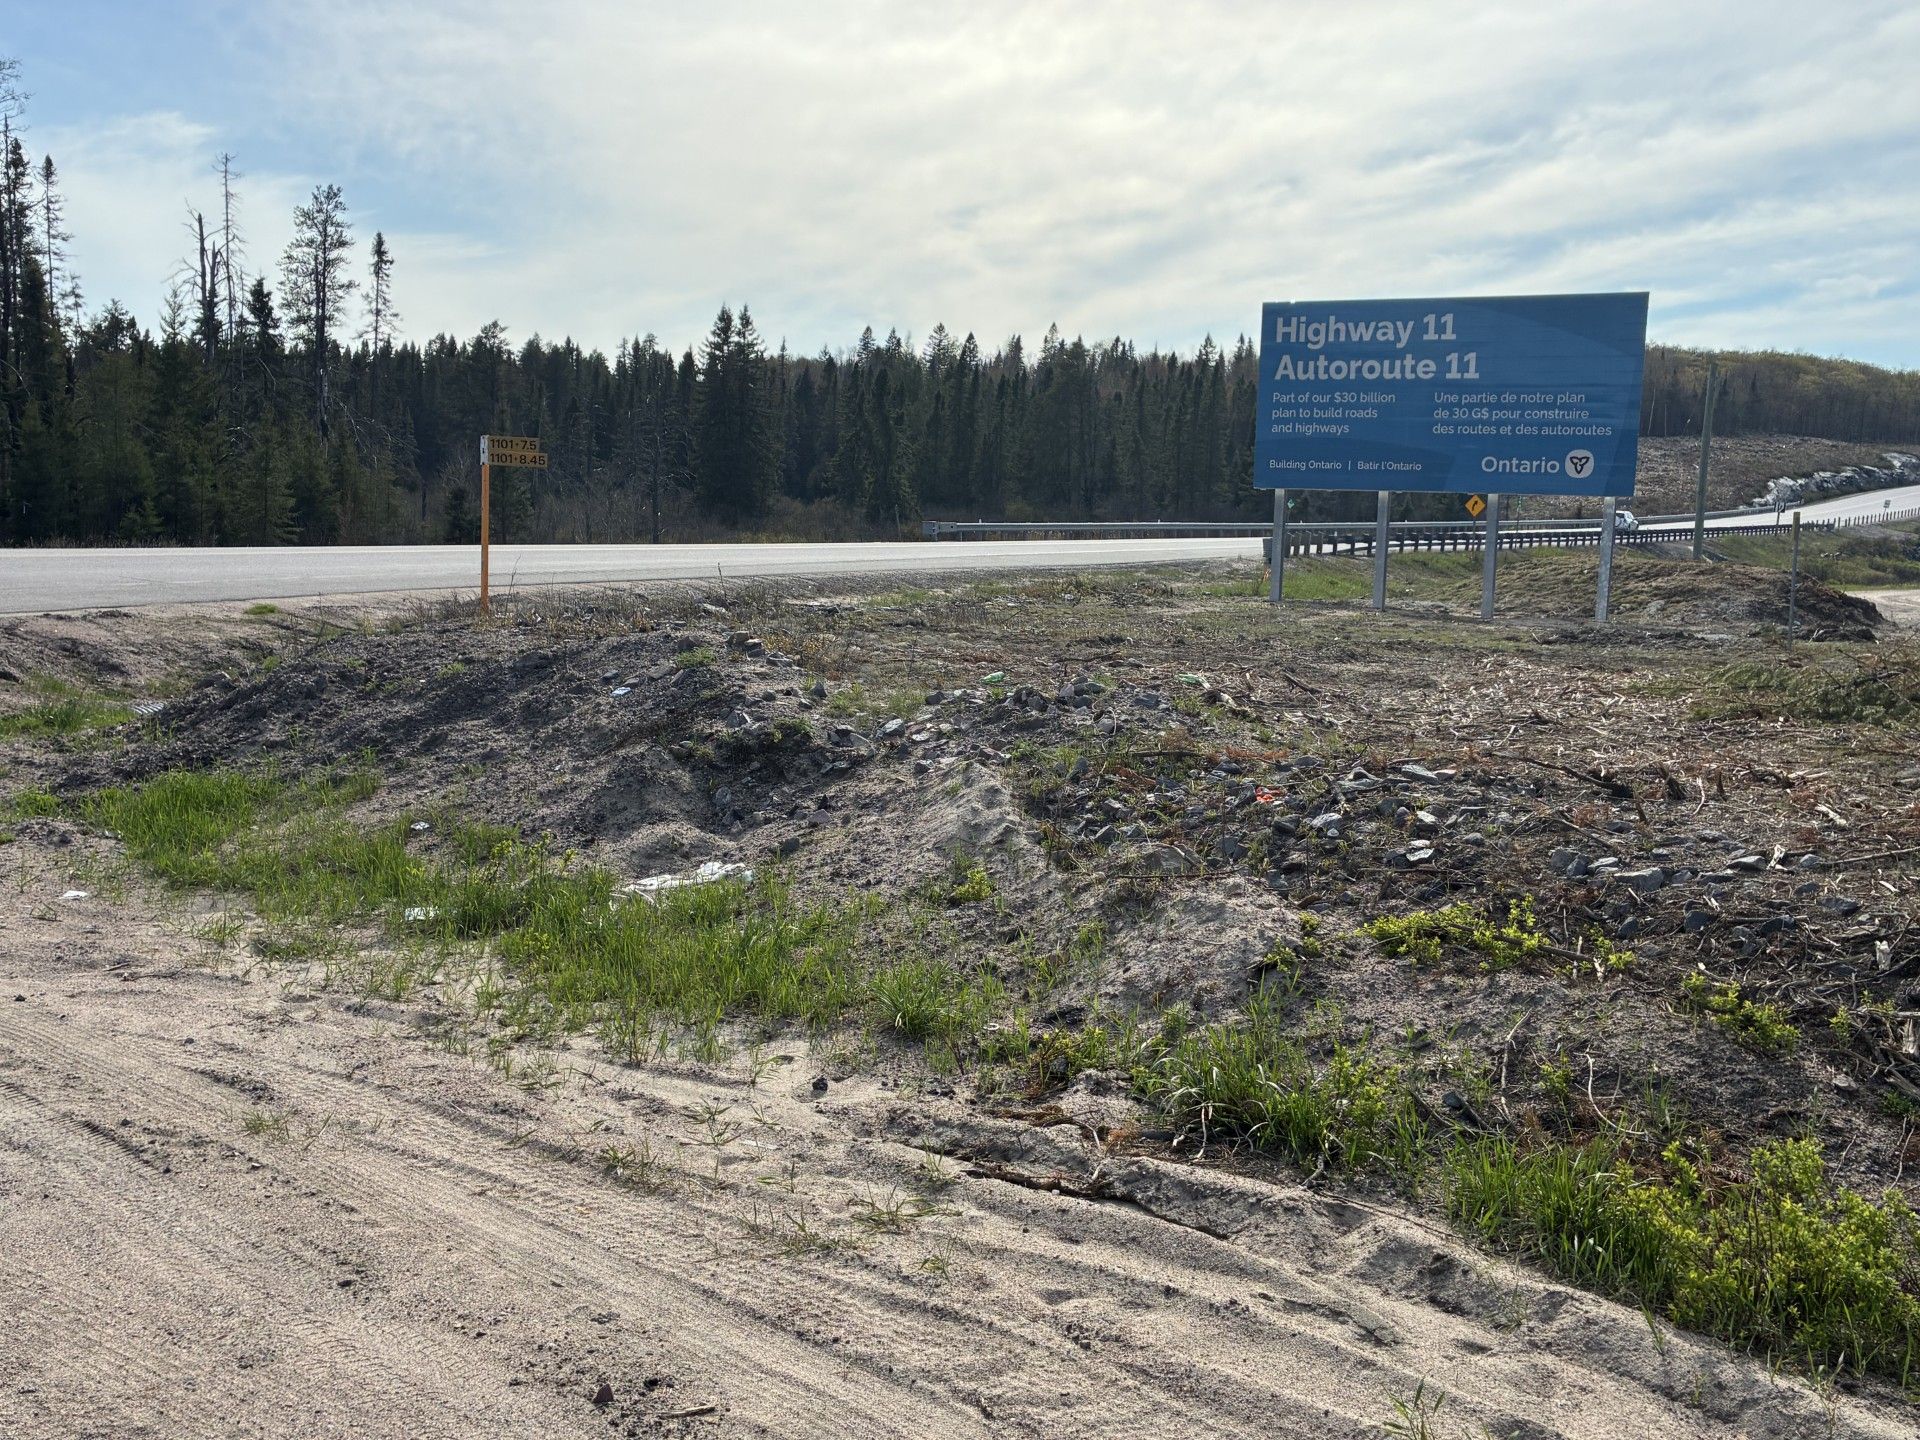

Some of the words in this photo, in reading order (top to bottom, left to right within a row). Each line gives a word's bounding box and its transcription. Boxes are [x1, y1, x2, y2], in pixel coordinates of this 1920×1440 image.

[1275, 315, 1415, 349] Highway
[1423, 313, 1457, 341] 11
[1274, 354, 1437, 380] Autoroute
[1445, 352, 1480, 379] 11
[1272, 392, 1295, 403] Part
[1298, 392, 1309, 403] of
[1312, 394, 1331, 403] our
[1334, 391, 1357, 404] $30
[1360, 392, 1396, 404] billion
[1434, 392, 1458, 403] Une
[1462, 392, 1498, 406] partie
[1500, 392, 1517, 403] de
[1520, 393, 1554, 404] notre
[1557, 392, 1586, 406] plan
[1272, 408, 1297, 420] plan
[1300, 408, 1311, 418] to
[1314, 408, 1343, 418] build
[1345, 408, 1378, 419] roads
[1433, 408, 1450, 419] de
[1452, 408, 1469, 419] 30
[1471, 407, 1489, 420] G$
[1492, 410, 1521, 421] pour
[1524, 408, 1590, 419] construire
[1271, 422, 1293, 433] and
[1295, 423, 1350, 436] highways
[1432, 423, 1455, 434] des
[1457, 424, 1497, 435] routes
[1500, 425, 1512, 436] et
[1515, 423, 1539, 435] des
[1541, 425, 1612, 436] autoroutes
[1269, 459, 1306, 471] Building
[1308, 460, 1343, 470] Ontario
[1381, 461, 1422, 471] l'Ontario
[1481, 456, 1560, 474] Ontario
